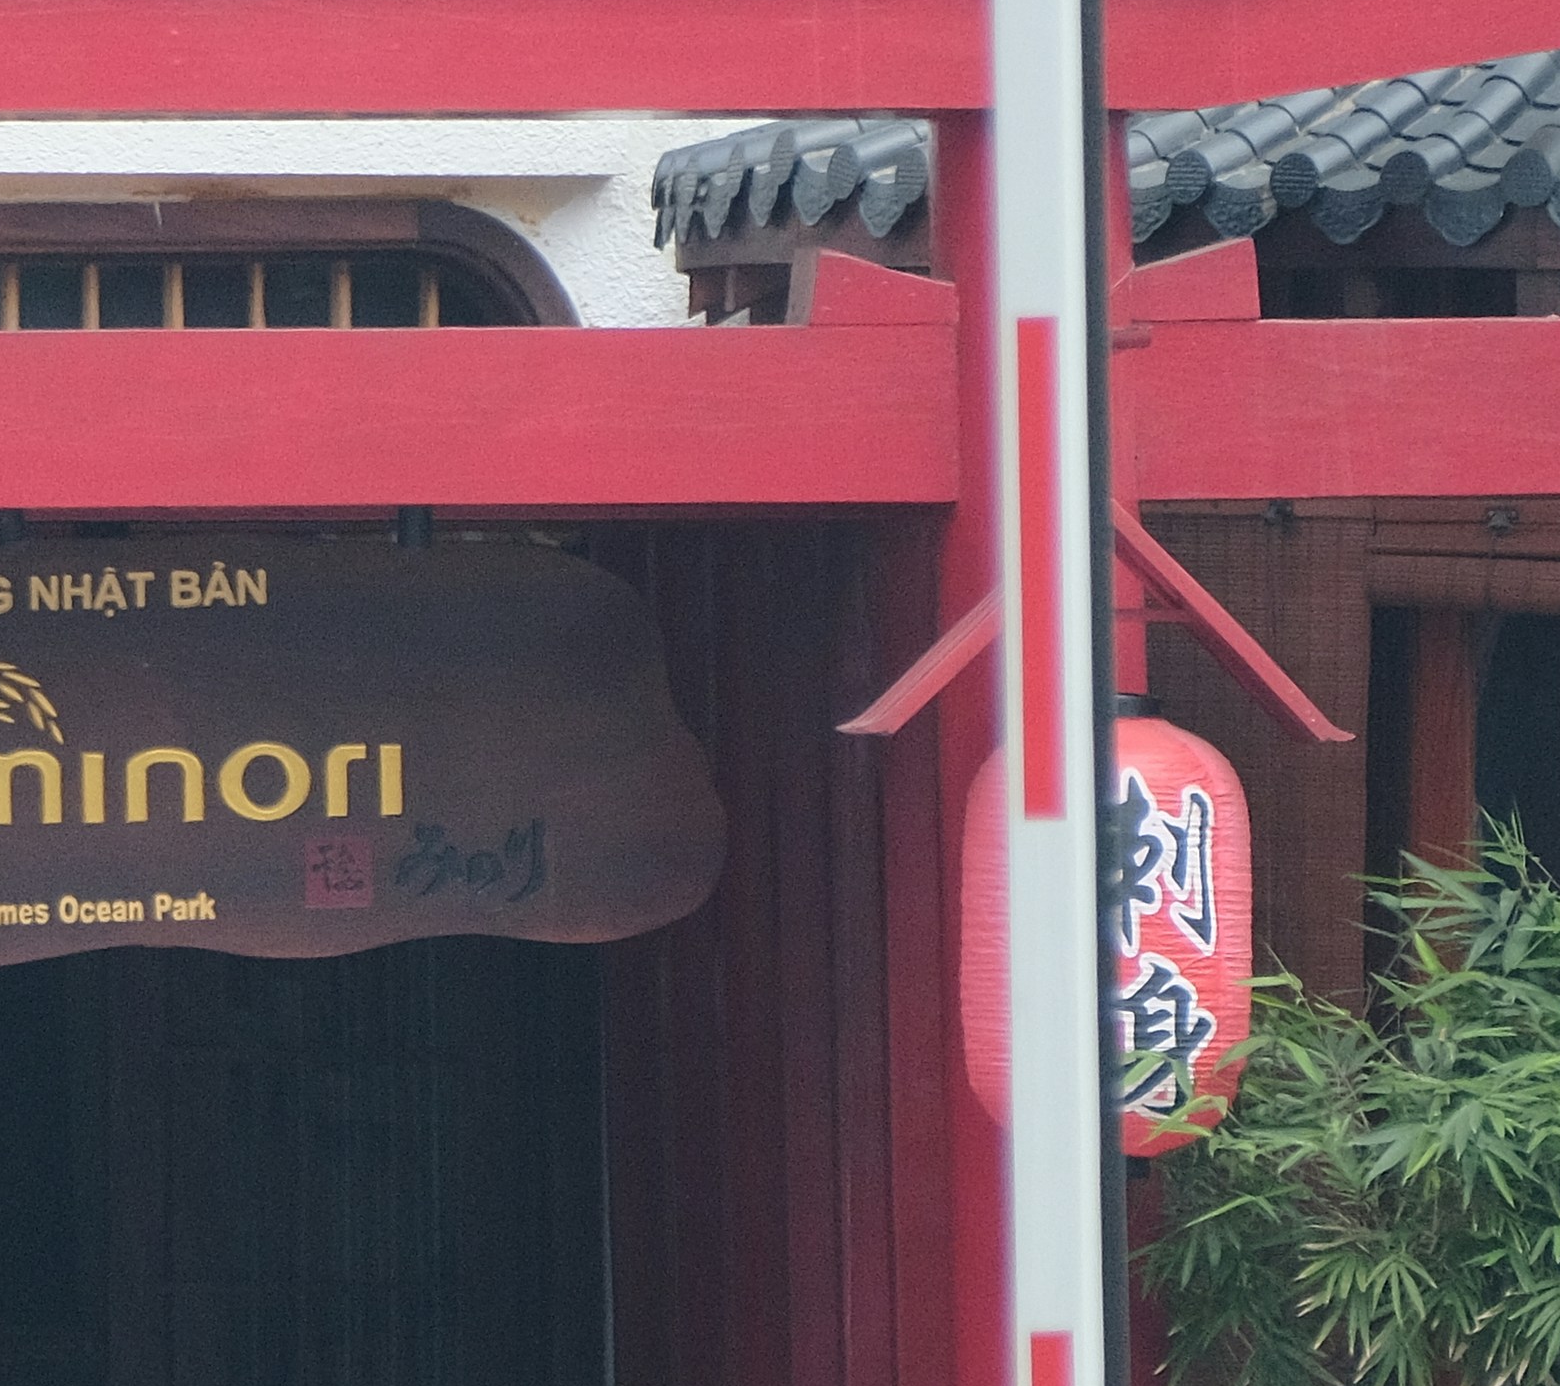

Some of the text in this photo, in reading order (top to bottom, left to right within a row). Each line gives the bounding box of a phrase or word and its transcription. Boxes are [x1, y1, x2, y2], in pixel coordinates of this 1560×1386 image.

[28, 566, 156, 619] NHẬT
[169, 560, 269, 609] BẢN
[58, 894, 145, 924] Ocean
[153, 890, 217, 922] Park
